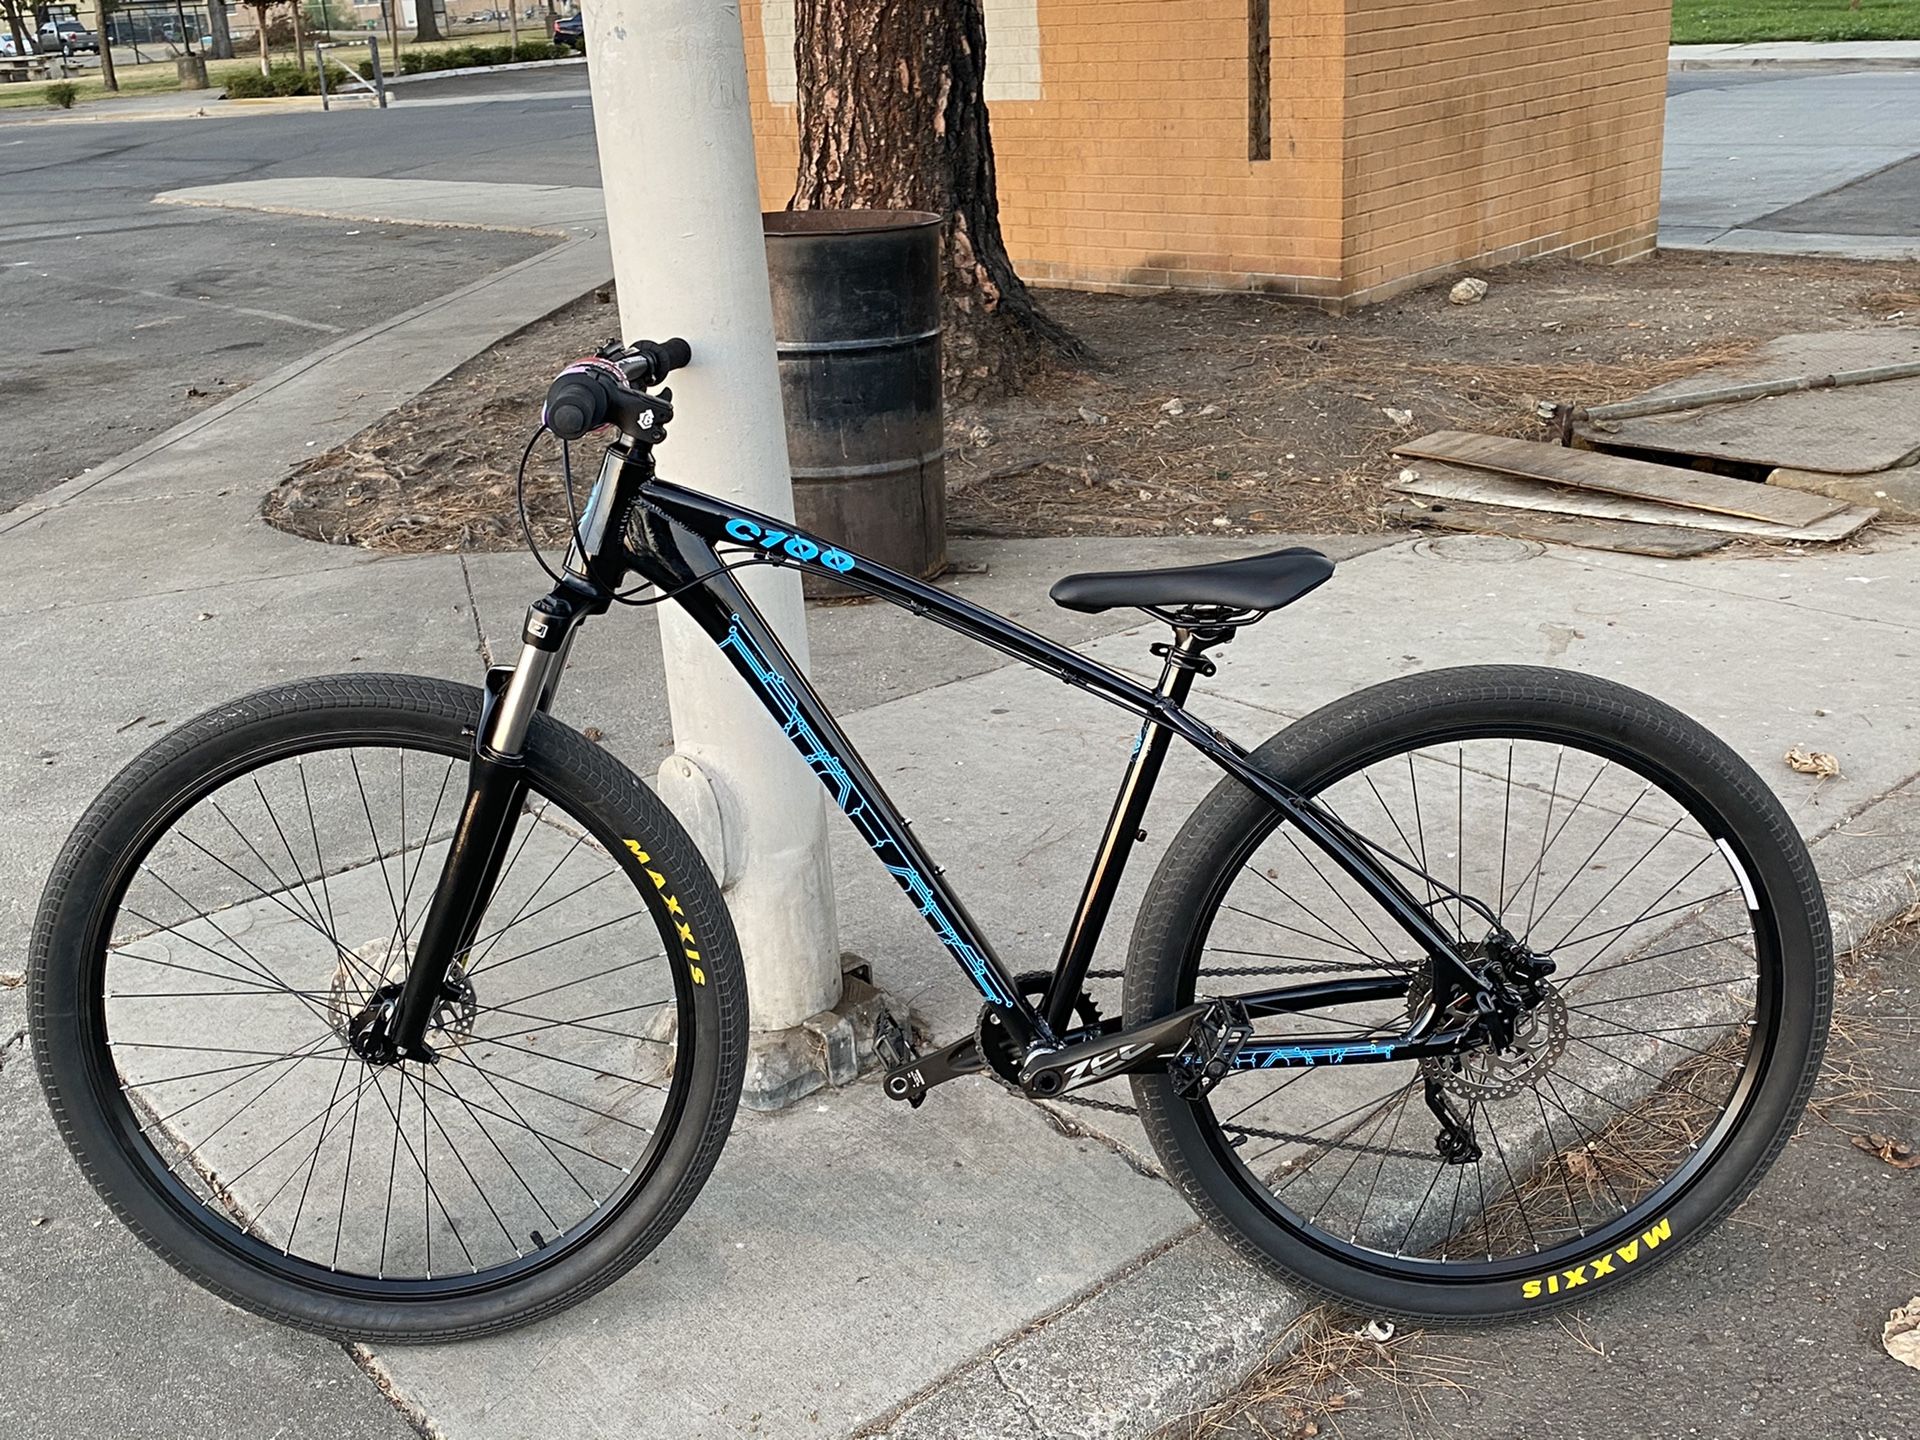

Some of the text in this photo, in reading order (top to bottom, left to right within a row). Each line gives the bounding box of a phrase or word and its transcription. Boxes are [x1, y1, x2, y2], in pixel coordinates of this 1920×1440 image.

[622, 839, 706, 986] MAXXIS
[1063, 1042, 1155, 1092] ZEE
[1522, 1218, 1672, 1299] MAXXIS
